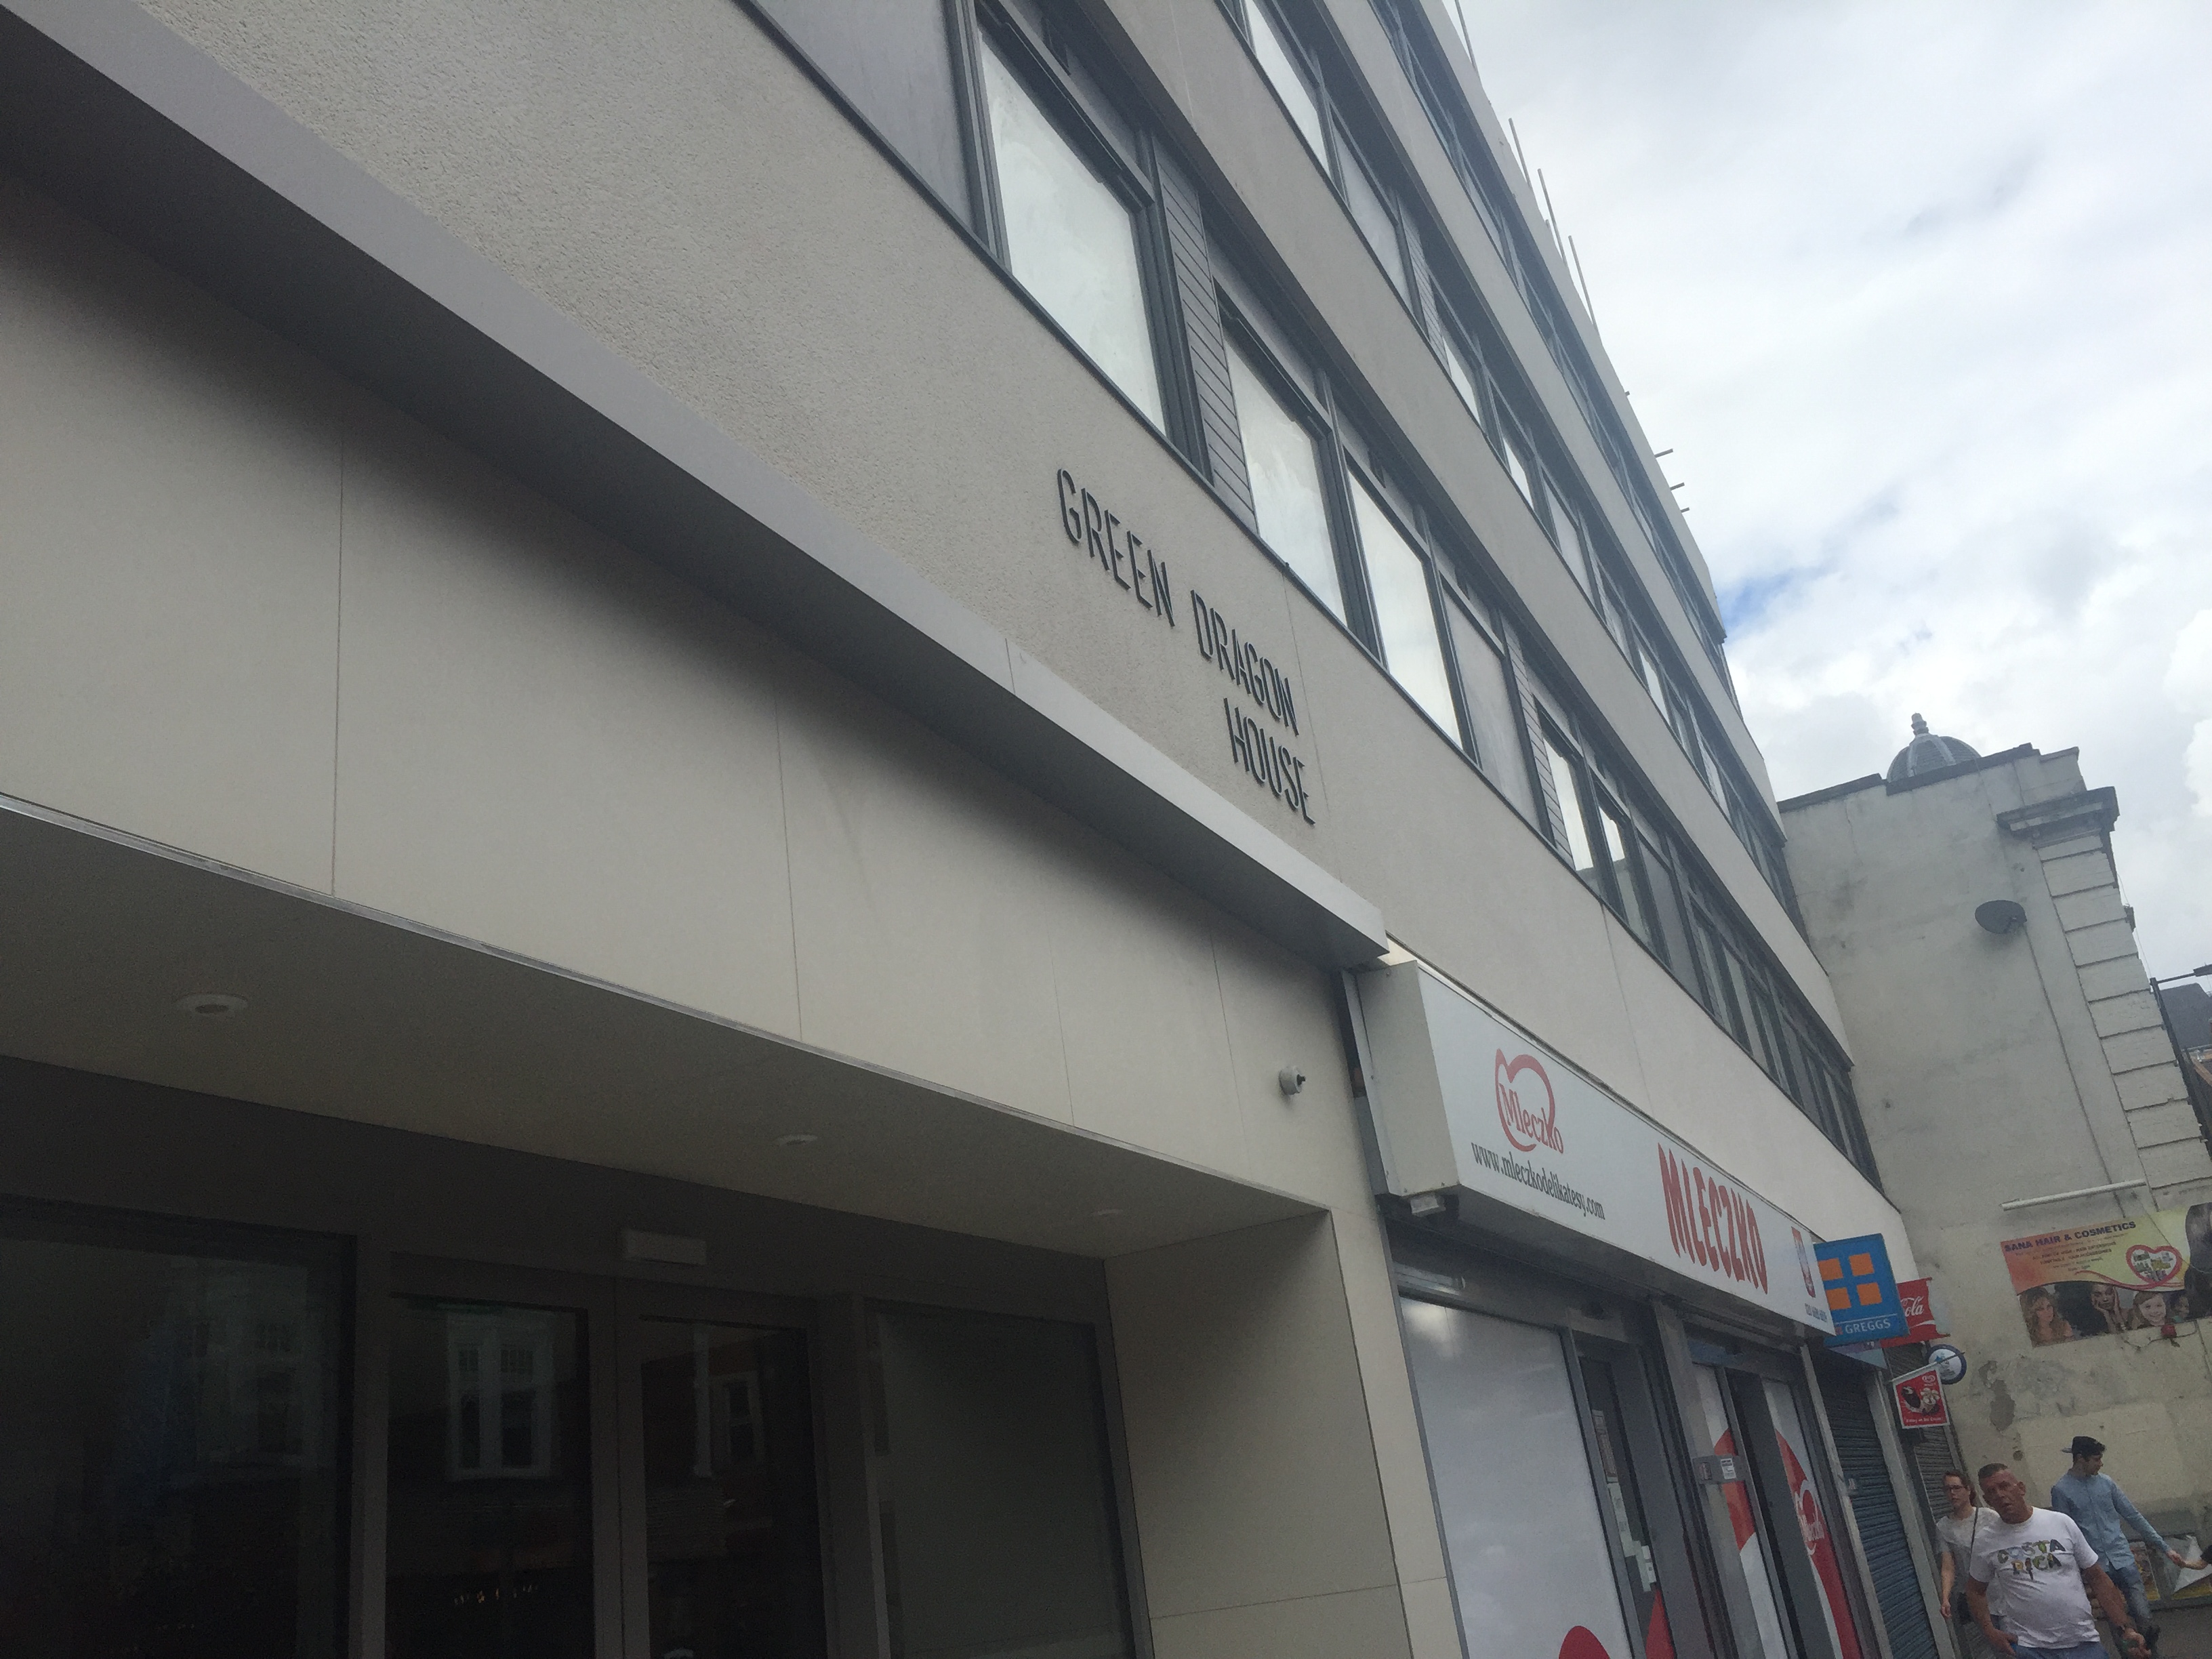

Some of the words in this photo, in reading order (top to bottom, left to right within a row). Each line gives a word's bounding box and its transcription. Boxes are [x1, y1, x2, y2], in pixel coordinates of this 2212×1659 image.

[1057, 468, 1175, 627] GREEN
[1191, 589, 1299, 737] DRAGON
[1224, 697, 1315, 825] HOUSE
[1498, 1082, 1564, 1154] Mleczko
[1471, 1142, 1605, 1220] www.mleczkodelikatesy.com
[1658, 1143, 1768, 1295] MLECZKO
[2004, 1241, 2033, 1252] SANA
[2035, 1235, 2061, 1247] HAIR
[2074, 1221, 2136, 1240] COSMETICS
[1845, 1318, 1891, 1334] GREGGS
[1997, 1539, 2066, 1563] COSTA
[2011, 1553, 2062, 1580] RICA
